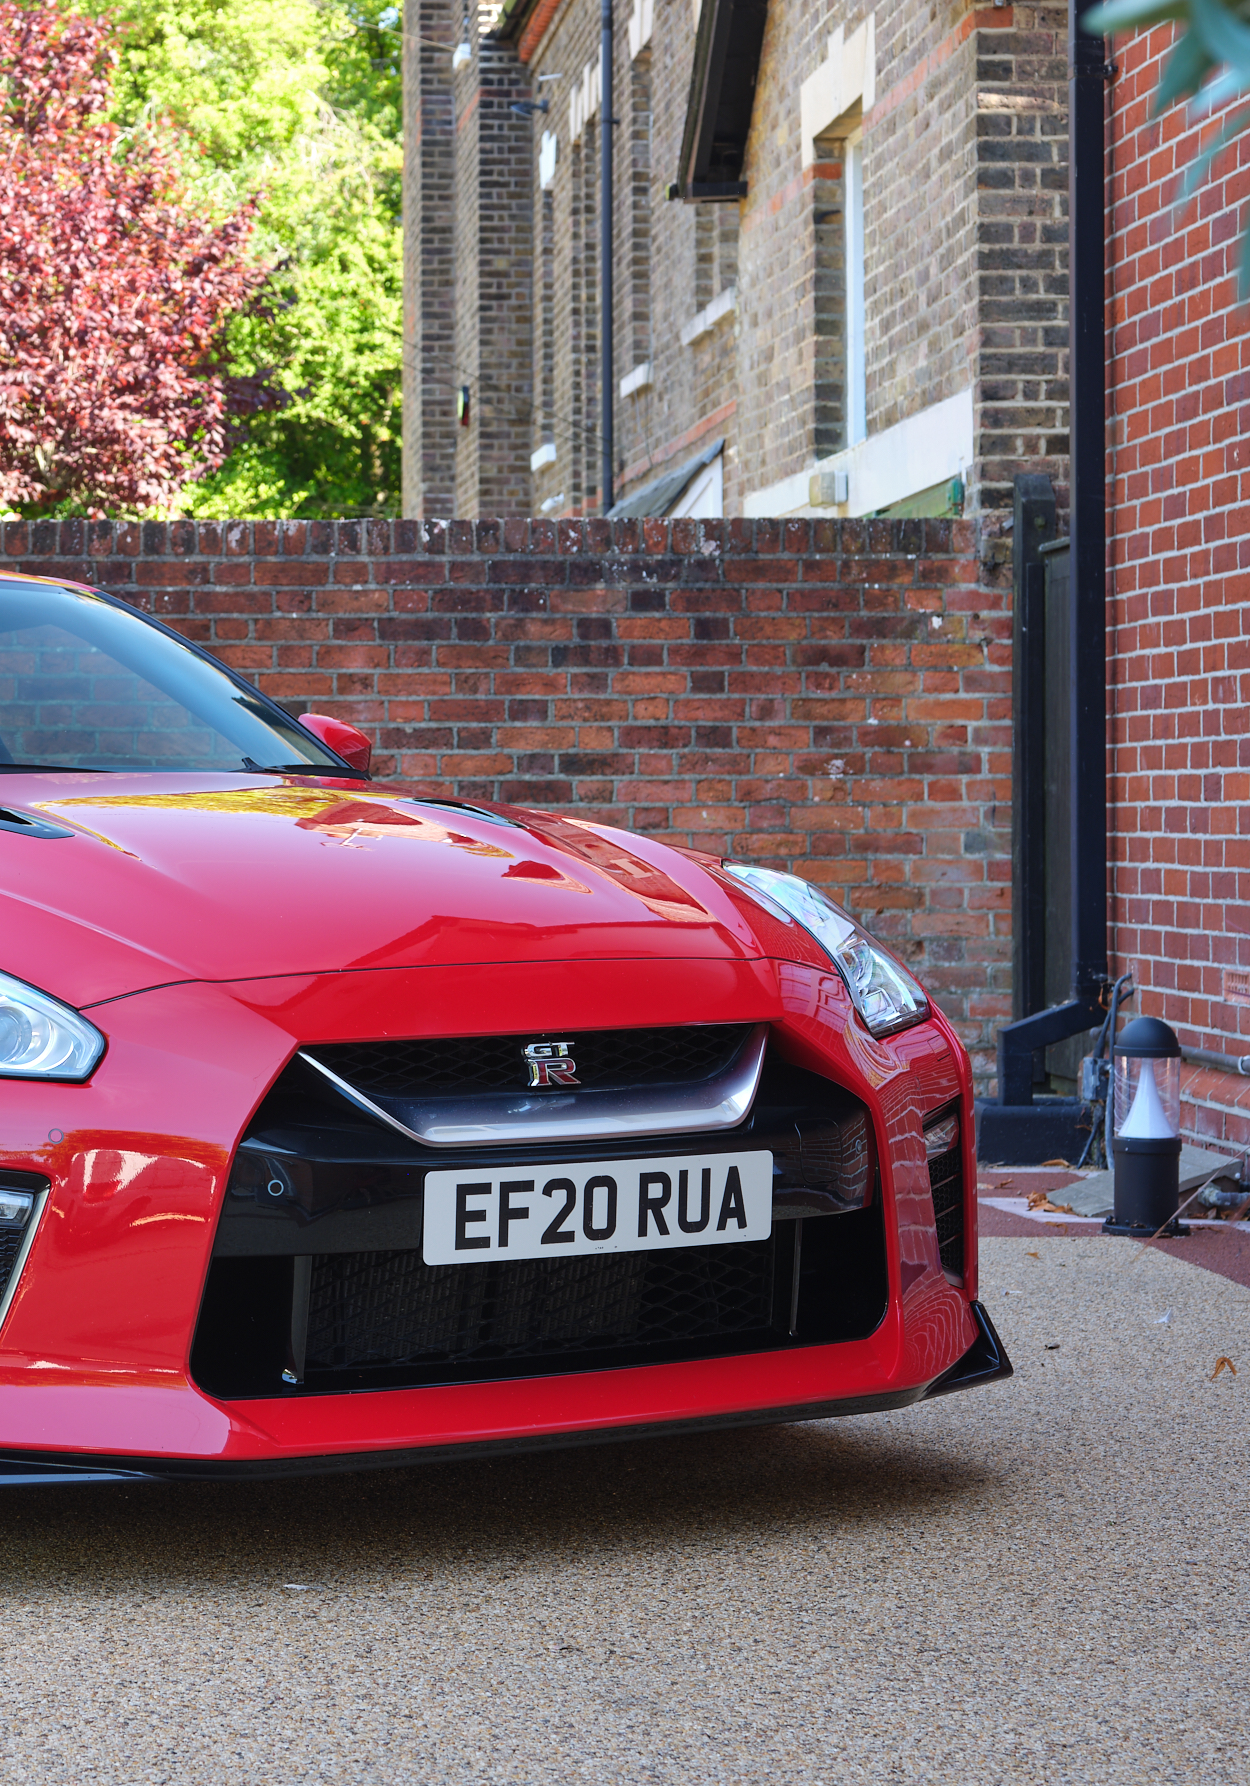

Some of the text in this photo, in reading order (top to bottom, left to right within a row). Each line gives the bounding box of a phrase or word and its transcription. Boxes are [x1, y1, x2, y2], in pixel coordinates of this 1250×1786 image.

[522, 1041, 575, 1059] GT
[526, 1057, 581, 1087] R
[454, 1165, 748, 1251] EF20 RUA
